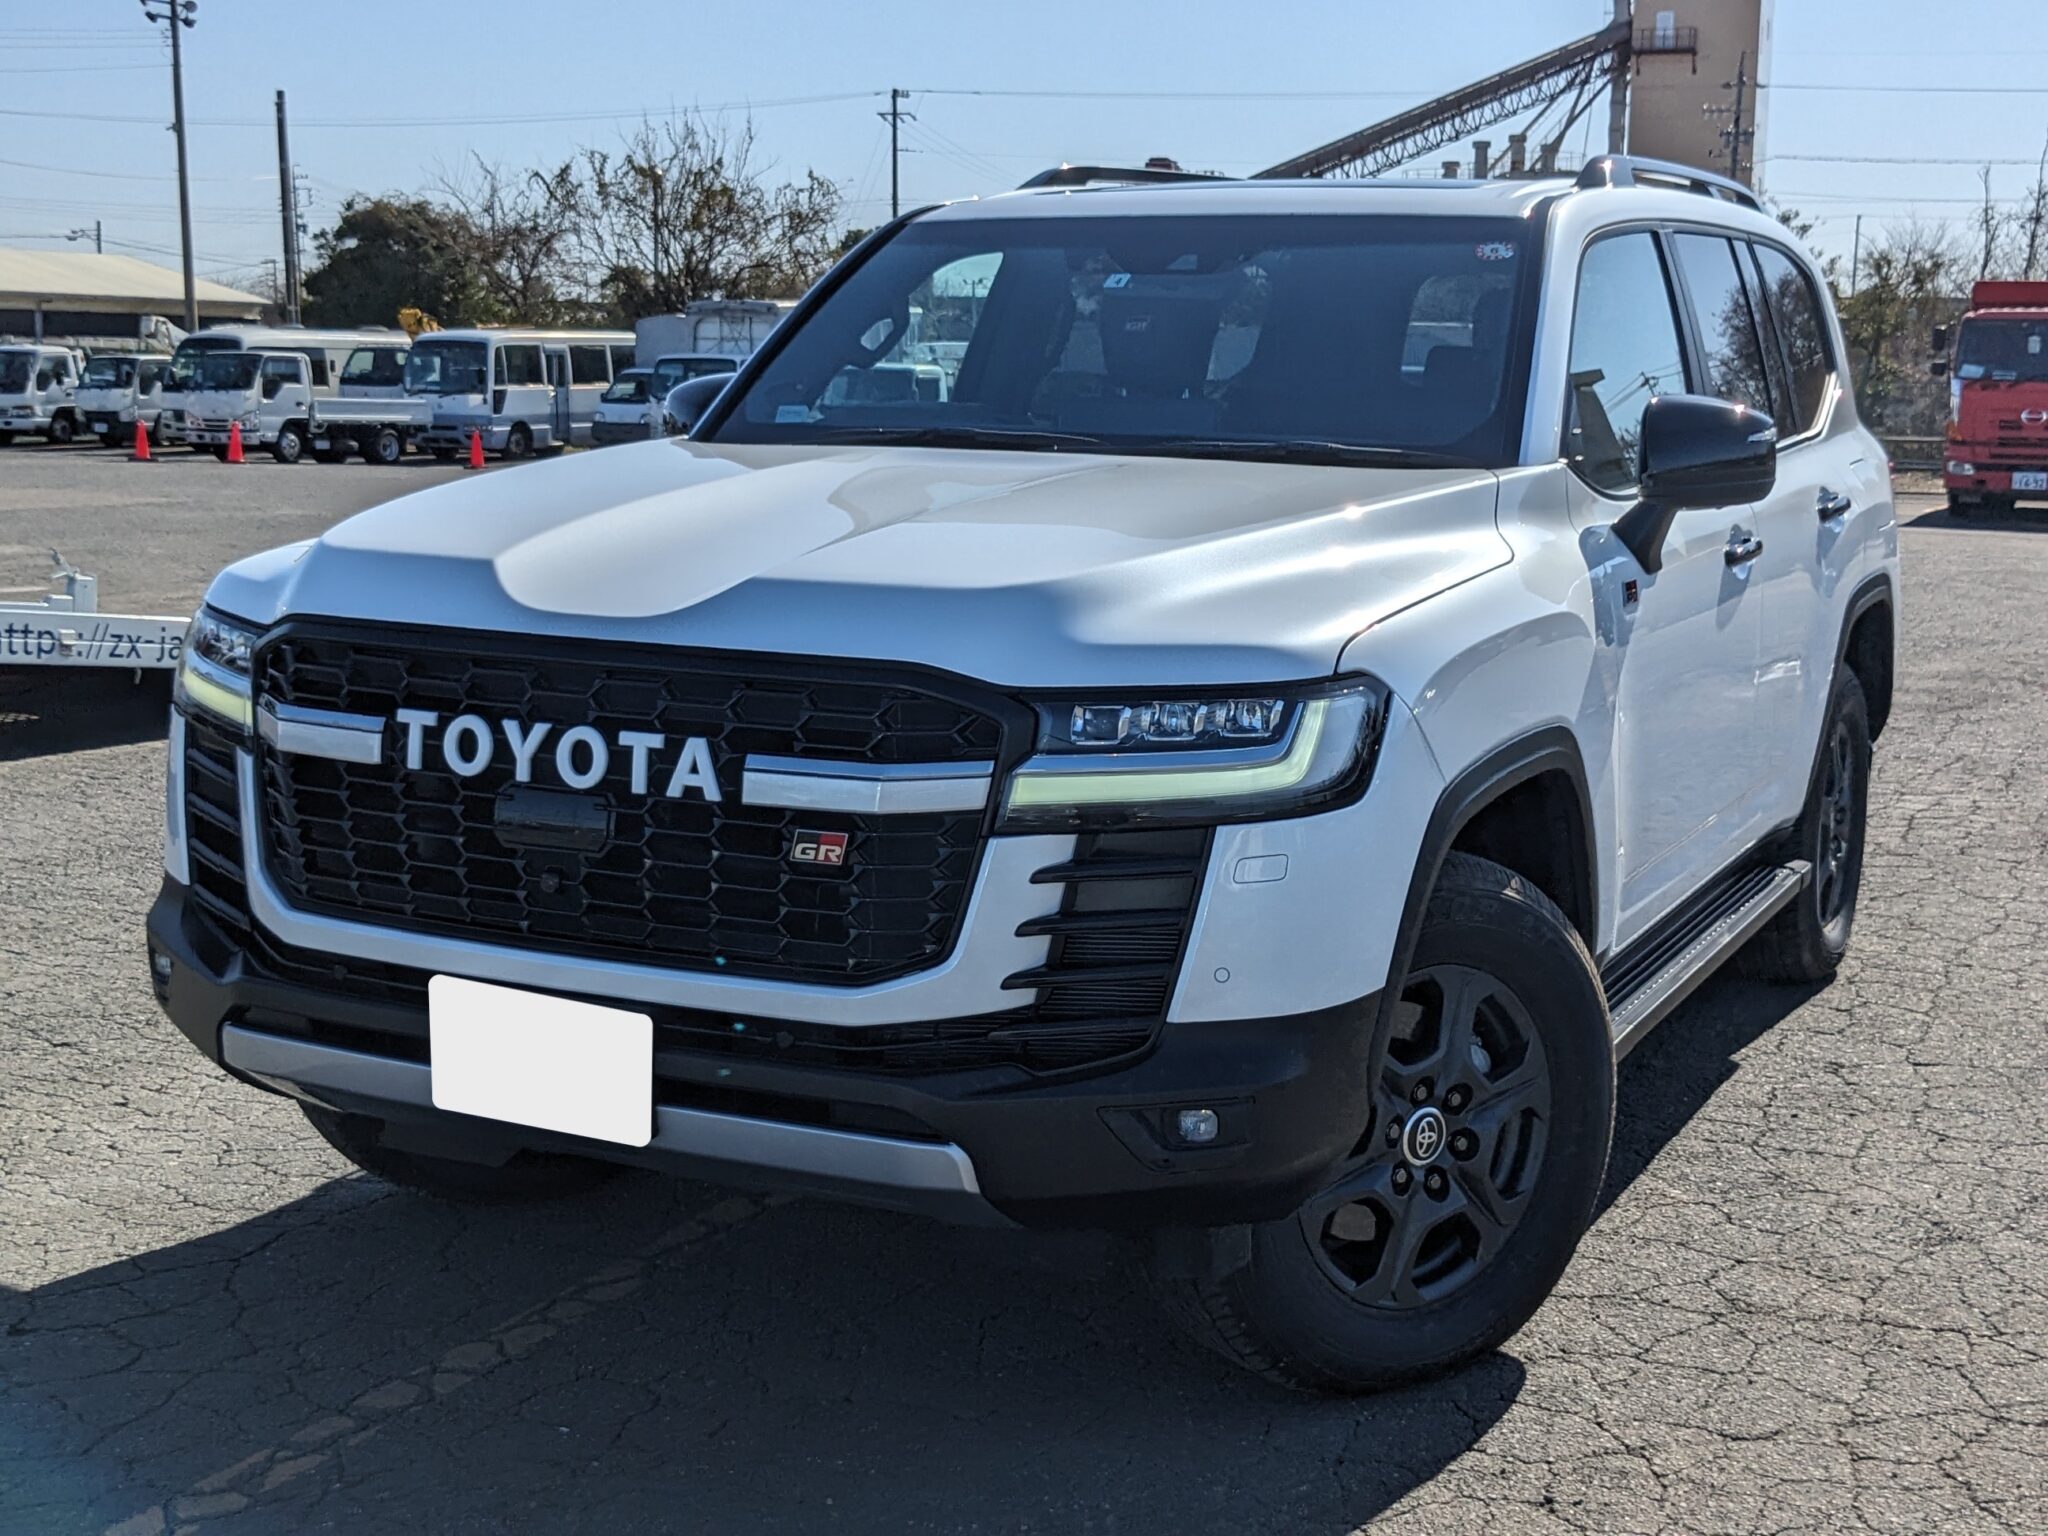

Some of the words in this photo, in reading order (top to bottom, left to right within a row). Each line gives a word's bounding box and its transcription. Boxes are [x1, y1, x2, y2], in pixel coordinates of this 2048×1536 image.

[0, 623, 183, 663] ttp://zx-ja
[396, 708, 722, 801] TOYOTA
[794, 843, 842, 862] GR
